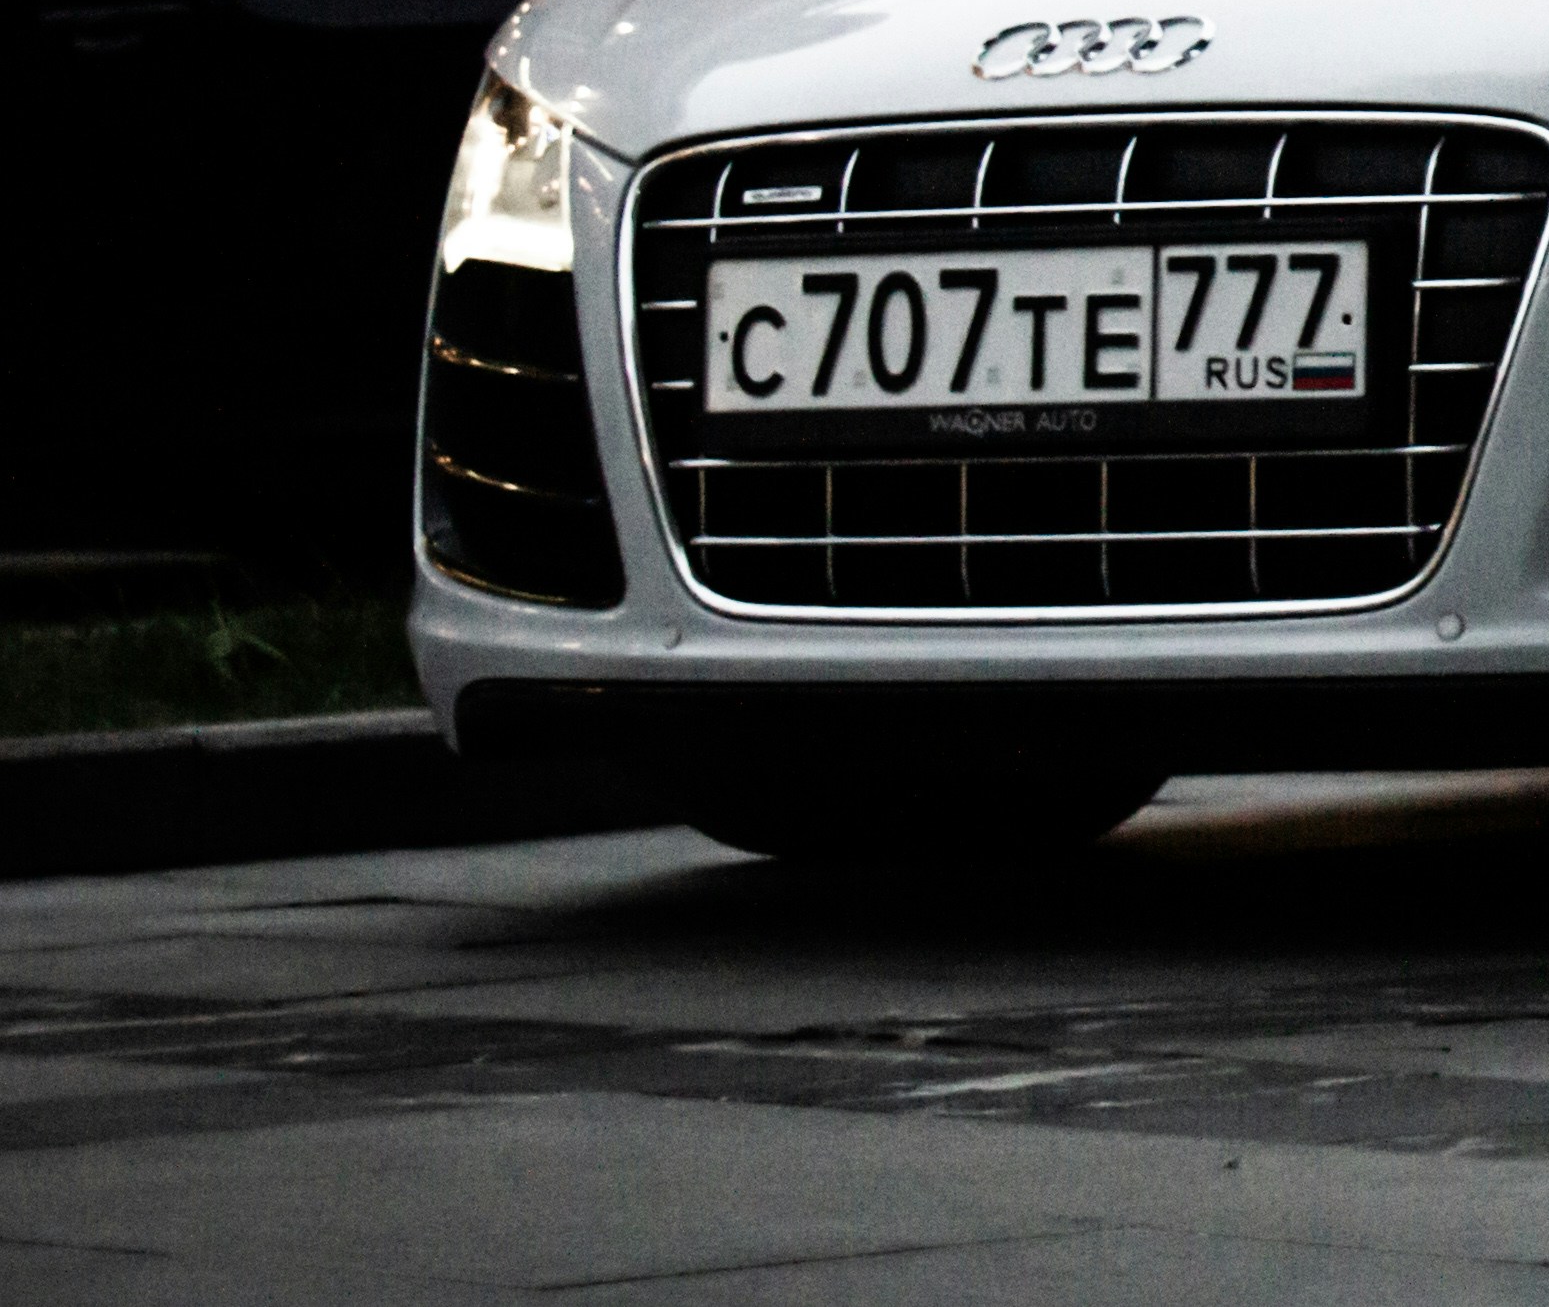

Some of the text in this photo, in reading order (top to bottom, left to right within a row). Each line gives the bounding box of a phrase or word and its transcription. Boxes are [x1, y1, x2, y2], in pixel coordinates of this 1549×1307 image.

[731, 268, 1141, 398] C707TE
[1167, 253, 1340, 352] 777
[1206, 356, 1288, 390] RUS
[929, 408, 1098, 438] WAGNER AUTO
